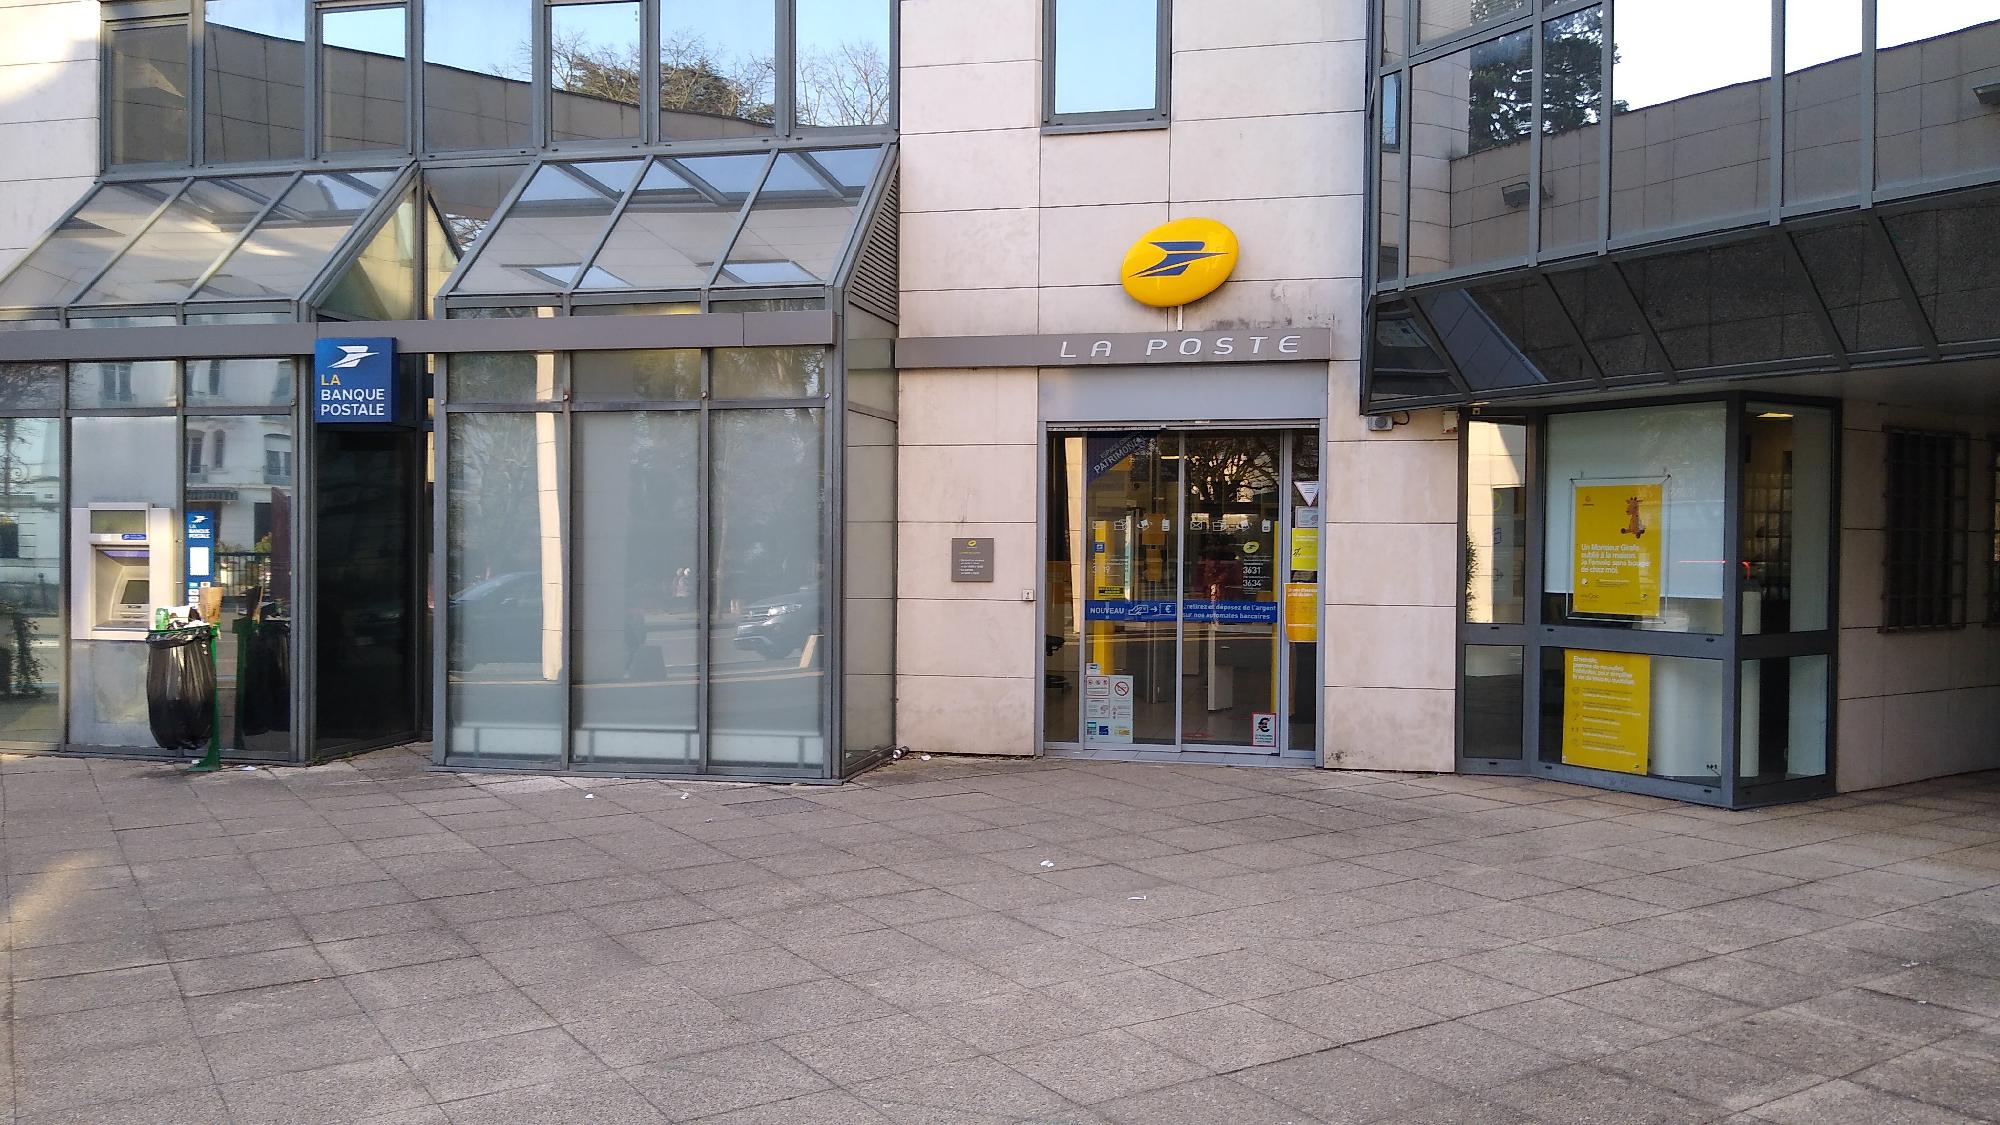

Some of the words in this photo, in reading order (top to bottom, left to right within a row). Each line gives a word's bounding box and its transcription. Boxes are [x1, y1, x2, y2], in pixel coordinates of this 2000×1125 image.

[1060, 340, 1112, 358] LA
[1145, 335, 1301, 356] POSTE
[320, 374, 341, 386] LA
[320, 388, 385, 402] BANQUE
[320, 403, 385, 416] POSTALE
[1252, 604, 1277, 612] l'argent
